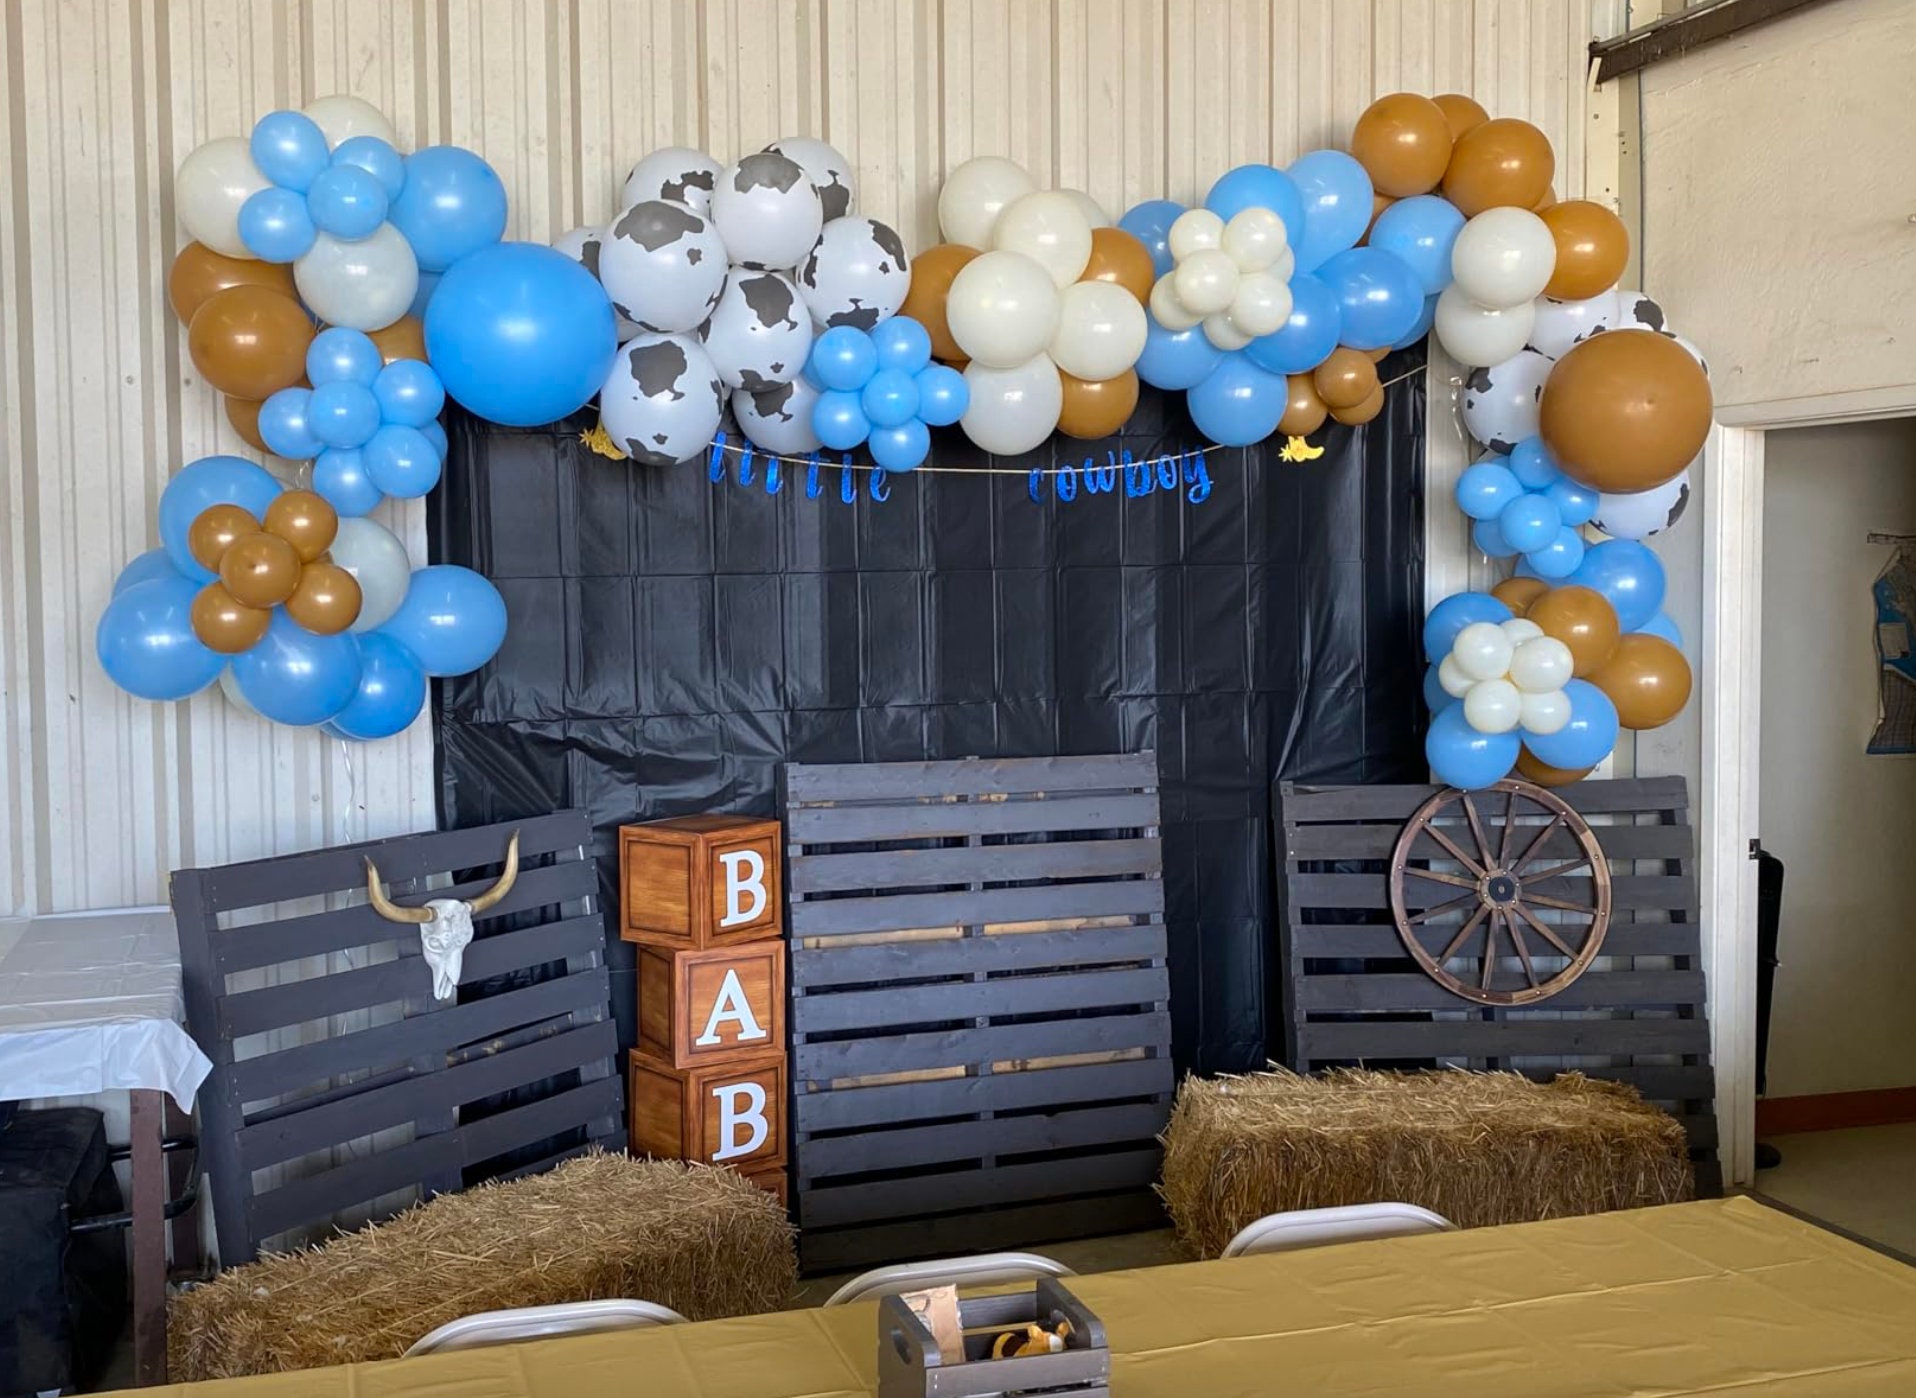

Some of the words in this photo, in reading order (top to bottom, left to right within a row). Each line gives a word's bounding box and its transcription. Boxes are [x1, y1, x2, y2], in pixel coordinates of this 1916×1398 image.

[1027, 446, 1215, 504] cowboy
[719, 849, 768, 928] B
[695, 968, 767, 1047] A
[712, 1081, 769, 1162] B
